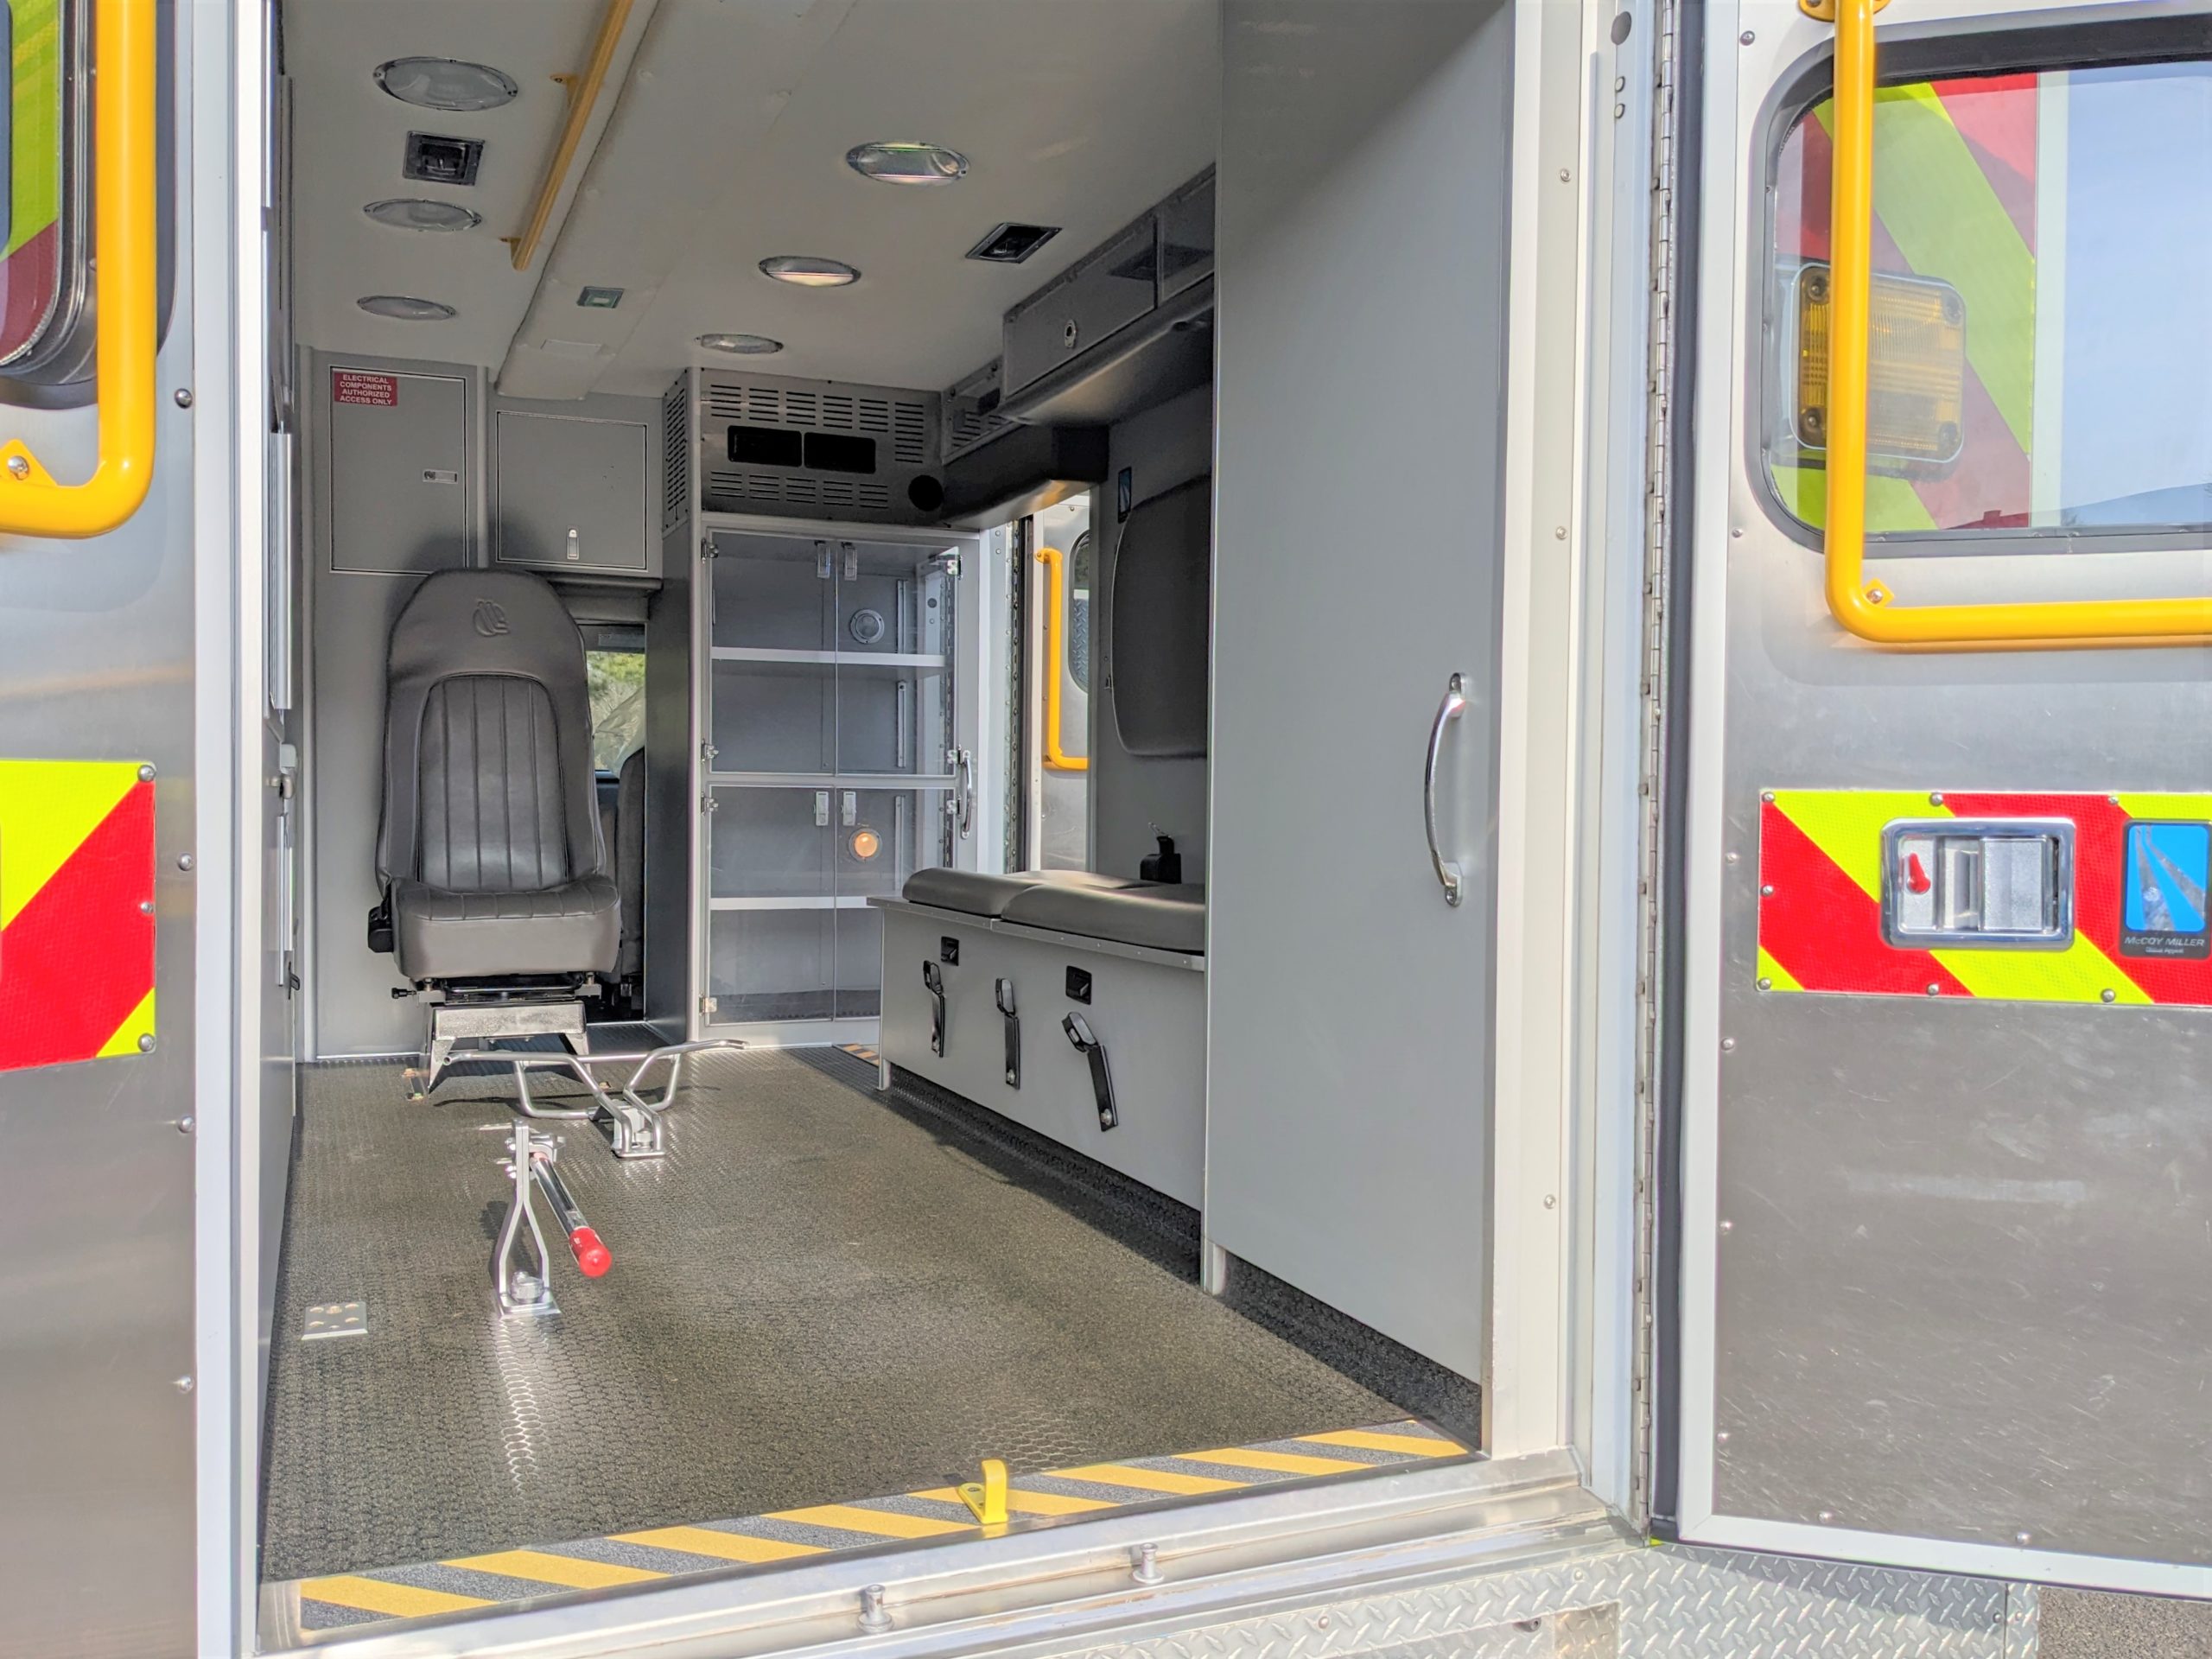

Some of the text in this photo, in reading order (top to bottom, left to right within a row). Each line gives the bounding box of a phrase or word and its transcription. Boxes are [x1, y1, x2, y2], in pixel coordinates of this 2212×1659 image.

[342, 374, 389, 385] ELECTRICAL
[340, 381, 392, 391] COMPONENTS
[342, 389, 390, 398] AUTHORIZED
[340, 396, 371, 404] ACCESS
[2124, 936, 2205, 947] McCOY MILLER
